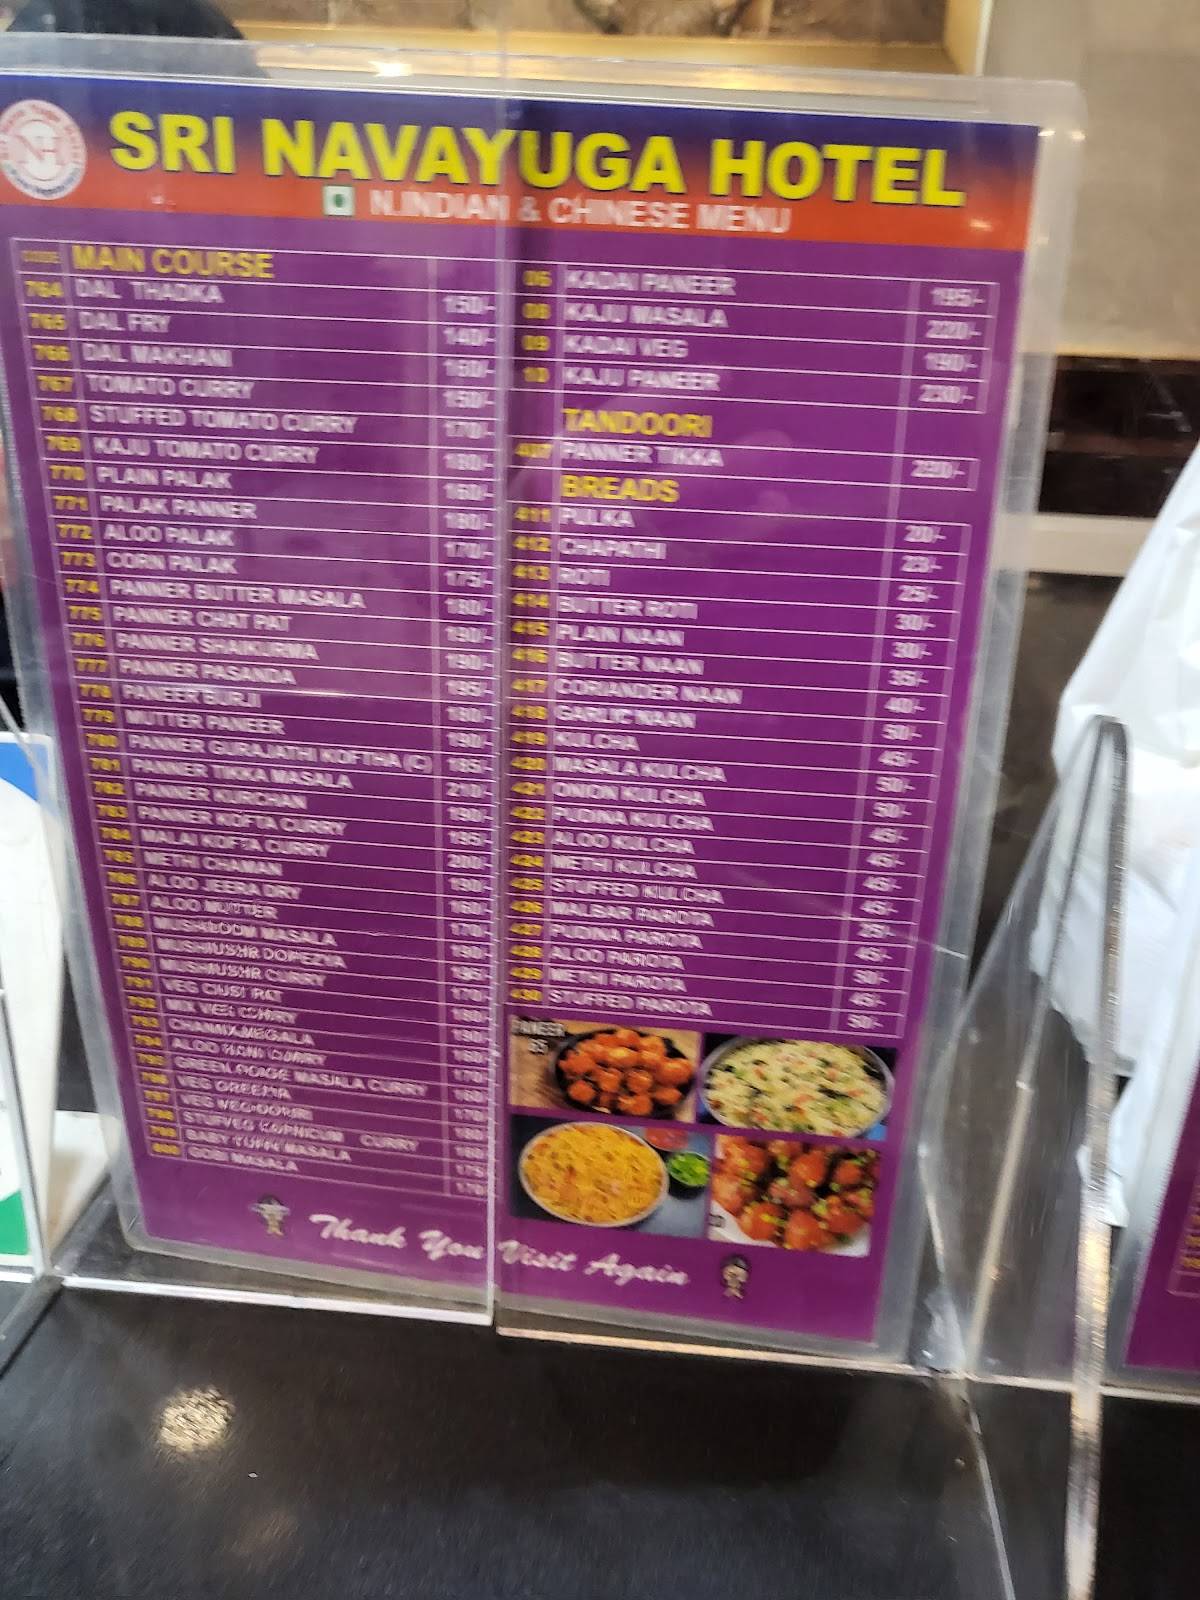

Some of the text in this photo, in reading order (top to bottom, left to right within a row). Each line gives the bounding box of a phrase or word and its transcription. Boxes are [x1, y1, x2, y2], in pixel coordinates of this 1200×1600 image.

[110, 109, 235, 175] SRI
[262, 118, 687, 196] NAVAYUGA
[709, 137, 967, 209] HOTEL
[369, 187, 791, 234] N.INDIAN & CHINESE MENU
[72, 245, 145, 273] MAIN
[152, 248, 275, 279] COURSE
[75, 279, 121, 299] DAL
[131, 281, 224, 303] THADKA
[566, 270, 640, 291] KADAI
[641, 273, 737, 296] PANEER
[79, 311, 125, 331] DAL
[127, 313, 171, 333] FRY
[563, 303, 729, 328] KAJU MASALA
[82, 343, 127, 363] DAL
[563, 334, 637, 355] KADAI
[638, 337, 688, 358] VEG
[86, 374, 175, 395] TOMATO
[179, 378, 255, 399] CURRY
[563, 367, 624, 386] KAJU
[627, 369, 720, 392] PANEER
[89, 405, 358, 434] STUFFED TOMATO CURRY
[561, 408, 713, 438] TANDOORI
[92, 437, 319, 464] KAJU TOMATO CURRY
[560, 441, 724, 467] PANNER TIKKA
[96, 466, 159, 486] PLAIN
[162, 469, 232, 489] PALAK
[560, 474, 680, 503] BREADS
[53, 494, 257, 520] 771 PALAK PANNER
[560, 507, 636, 528] PULKA
[56, 522, 235, 547] 772 ALOO PALAK
[60, 550, 238, 575] 773 CORN PALAK
[559, 567, 611, 586] ROTI
[64, 577, 367, 609] 774 PANNER BUTTER MASALA
[68, 605, 292, 632] 775 PANNER CHAT PAT
[558, 596, 644, 617] BUTTER
[645, 600, 698, 620] ROTI
[116, 633, 197, 653] PANNER
[557, 623, 621, 643] PLAIN
[621, 627, 685, 647] NAAN
[74, 657, 297, 685] 777 PANNER PASANDA
[557, 651, 642, 672] BUTTER
[642, 656, 704, 676] NAAN
[121, 684, 202, 704] PANEER
[555, 677, 681, 701] CORIANDER
[680, 685, 743, 704] NAAN
[82, 708, 285, 735] 779 MUTTER PANEER
[555, 704, 635, 725] GARLIC
[634, 709, 697, 729] NAAN
[128, 734, 208, 753] PANNER
[553, 730, 640, 752] KULCHA
[131, 758, 354, 790] PANNER TIKKA MASALA
[553, 756, 640, 777] MASALA
[639, 760, 728, 783] KULCHA
[135, 782, 211, 802] PANNER
[552, 781, 621, 801] ONION
[620, 786, 707, 807] KULCHA
[137, 805, 348, 836] PANNER KOFTA CURRY
[552, 805, 629, 826] PUDINA
[629, 811, 715, 832] KULCHA
[139, 828, 331, 858] MALAI KOFTA CURRY
[552, 830, 611, 849] ALOO
[611, 833, 696, 855] KULCHA
[143, 851, 201, 869] METHI
[552, 854, 698, 879] METHI KULCHA
[148, 873, 199, 891] ALOO
[551, 878, 725, 905] STUFFED KULCHA
[150, 895, 202, 913] ALOO
[261, 926, 338, 947] MASALA
[550, 923, 623, 943] PUDINA
[550, 947, 606, 964] ALOO
[550, 967, 609, 986] METHI
[549, 989, 635, 1010] STUFFED
[309, 1212, 690, 1287] Thank You Visit Again
